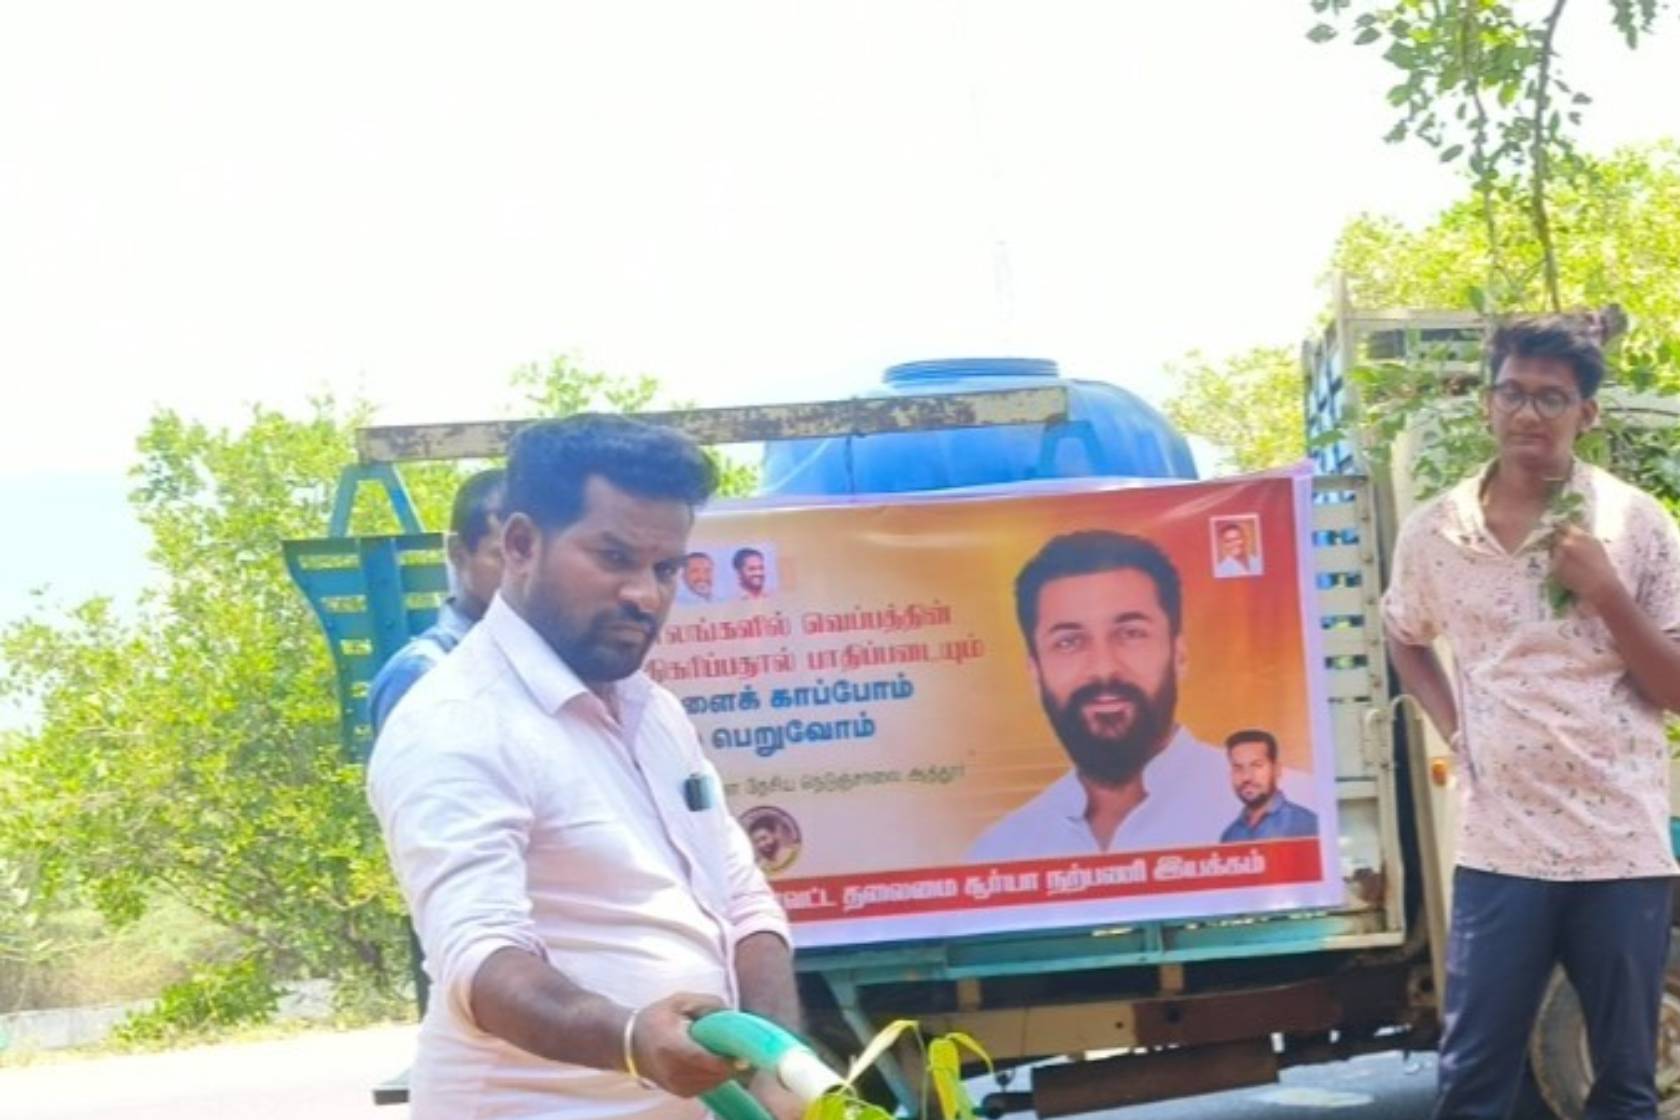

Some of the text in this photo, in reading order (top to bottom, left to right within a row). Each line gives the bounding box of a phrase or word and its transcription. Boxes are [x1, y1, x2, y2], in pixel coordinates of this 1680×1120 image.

[656, 598, 952, 644] லங்களில் வெப்பத்தின்
[807, 633, 986, 671] பாதிப்படையும்
[681, 672, 915, 715] ளைக் காப்போம்
[711, 711, 876, 757] பெறுவோம்
[843, 877, 958, 913] தலைமை
[964, 868, 1039, 900] சூர்யா
[1046, 858, 1147, 897] நற்பணி
[1154, 847, 1267, 882] இயக்கம்
